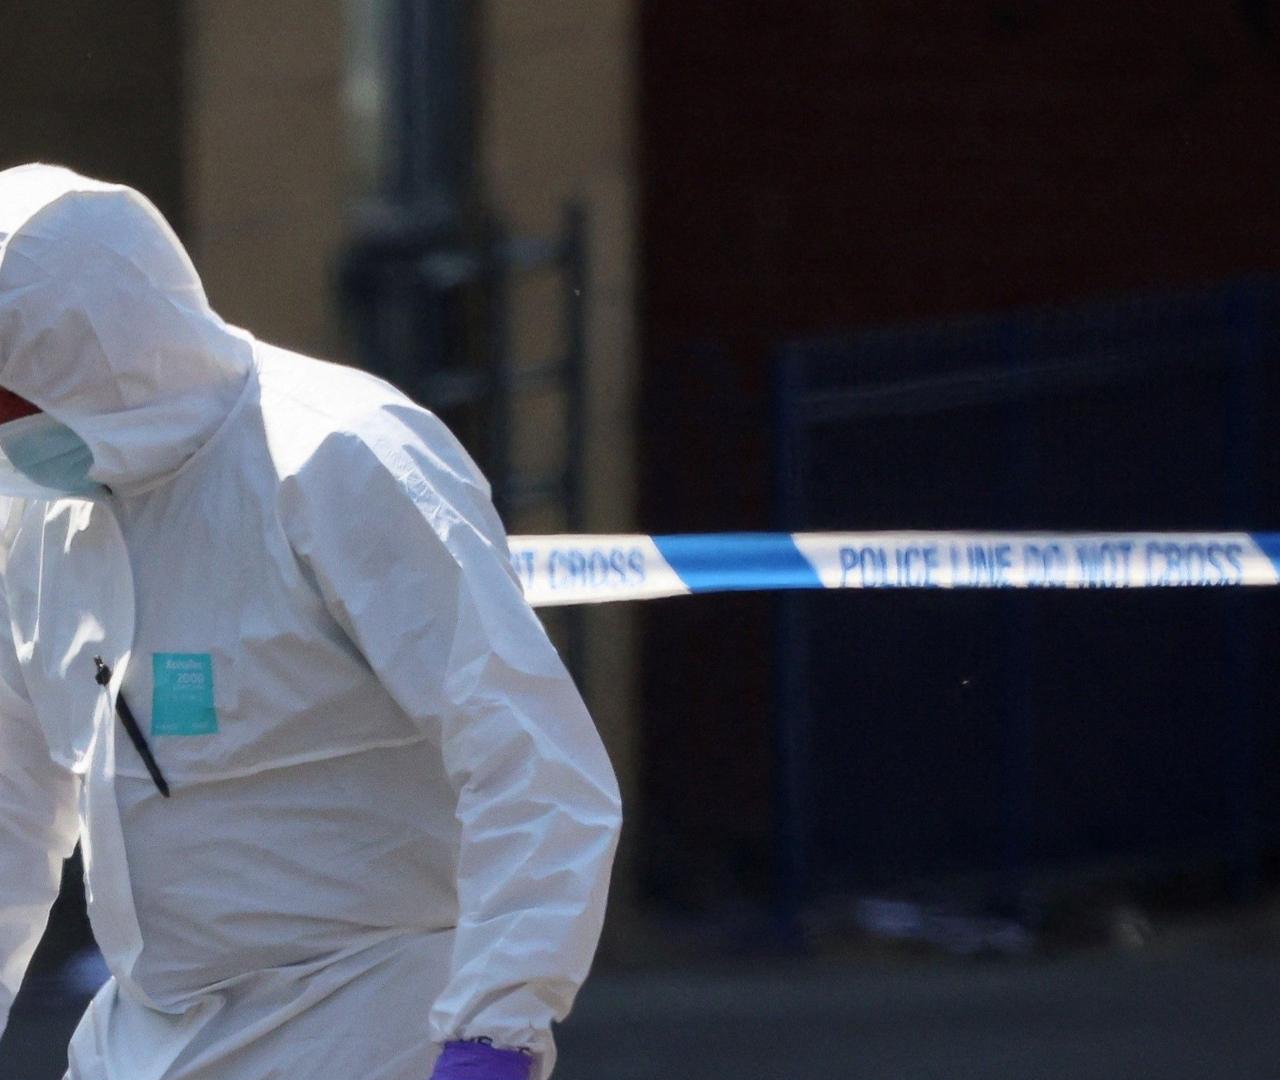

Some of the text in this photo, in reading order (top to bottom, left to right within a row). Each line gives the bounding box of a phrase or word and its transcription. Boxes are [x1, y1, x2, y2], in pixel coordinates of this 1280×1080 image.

[549, 549, 646, 590] CROSS
[841, 545, 939, 588] POLICE
[1145, 541, 1242, 587] CROSS
